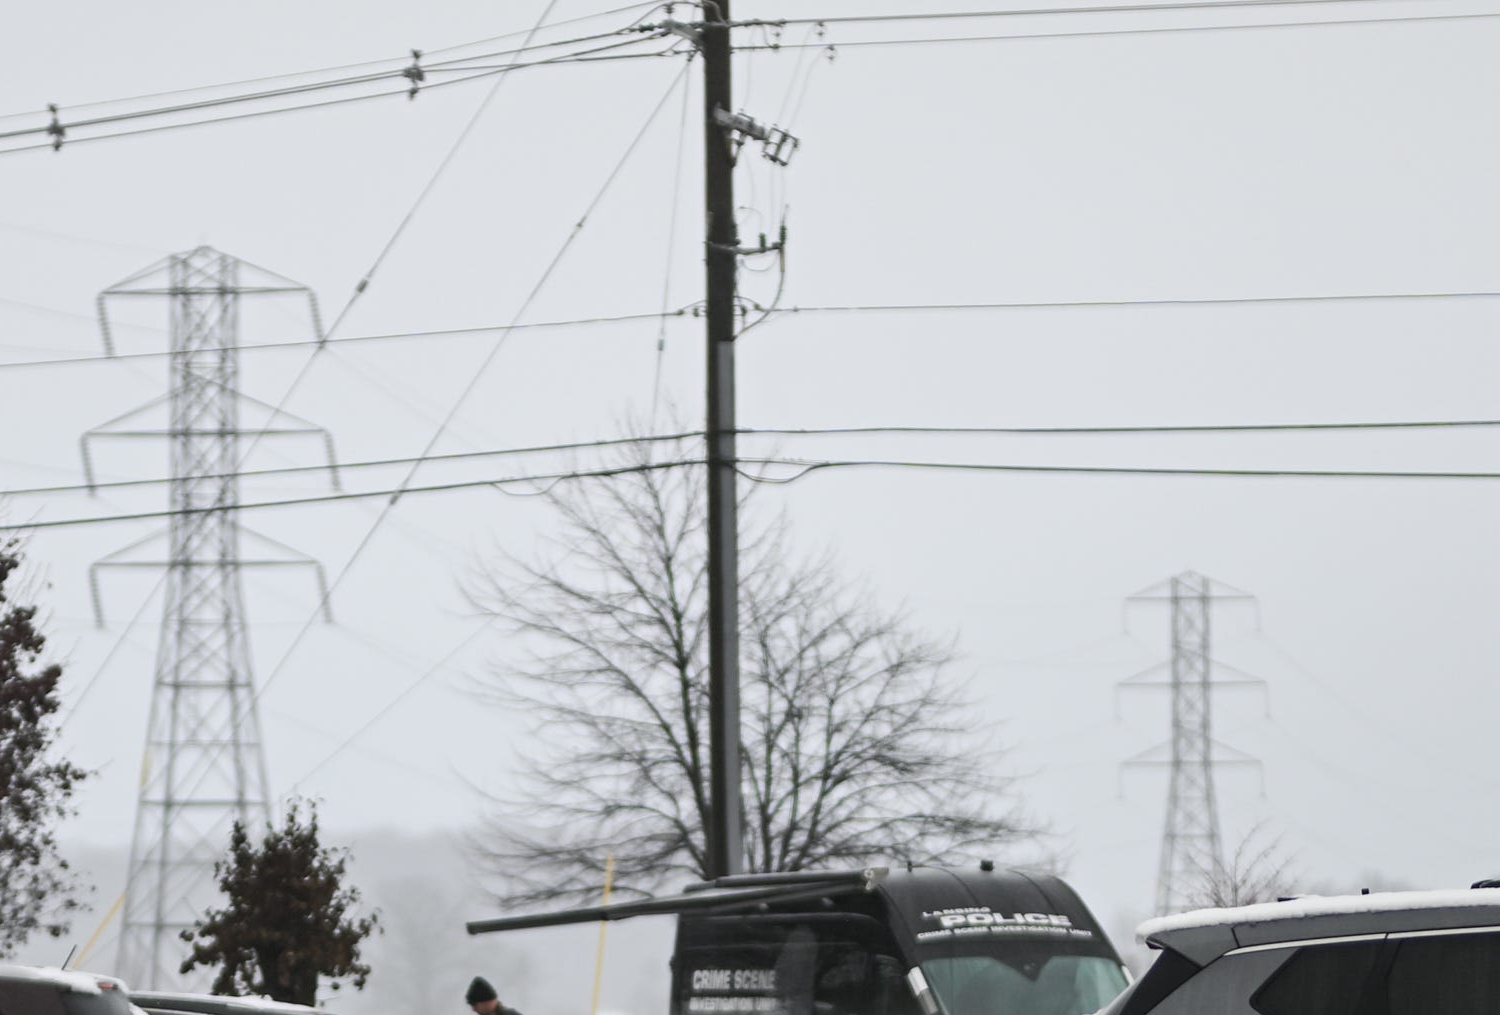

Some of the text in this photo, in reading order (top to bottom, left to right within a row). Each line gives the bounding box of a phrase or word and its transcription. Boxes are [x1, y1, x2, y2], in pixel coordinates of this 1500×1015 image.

[940, 912, 1072, 927] POLICE
[693, 969, 776, 990] CRIME SCENE
